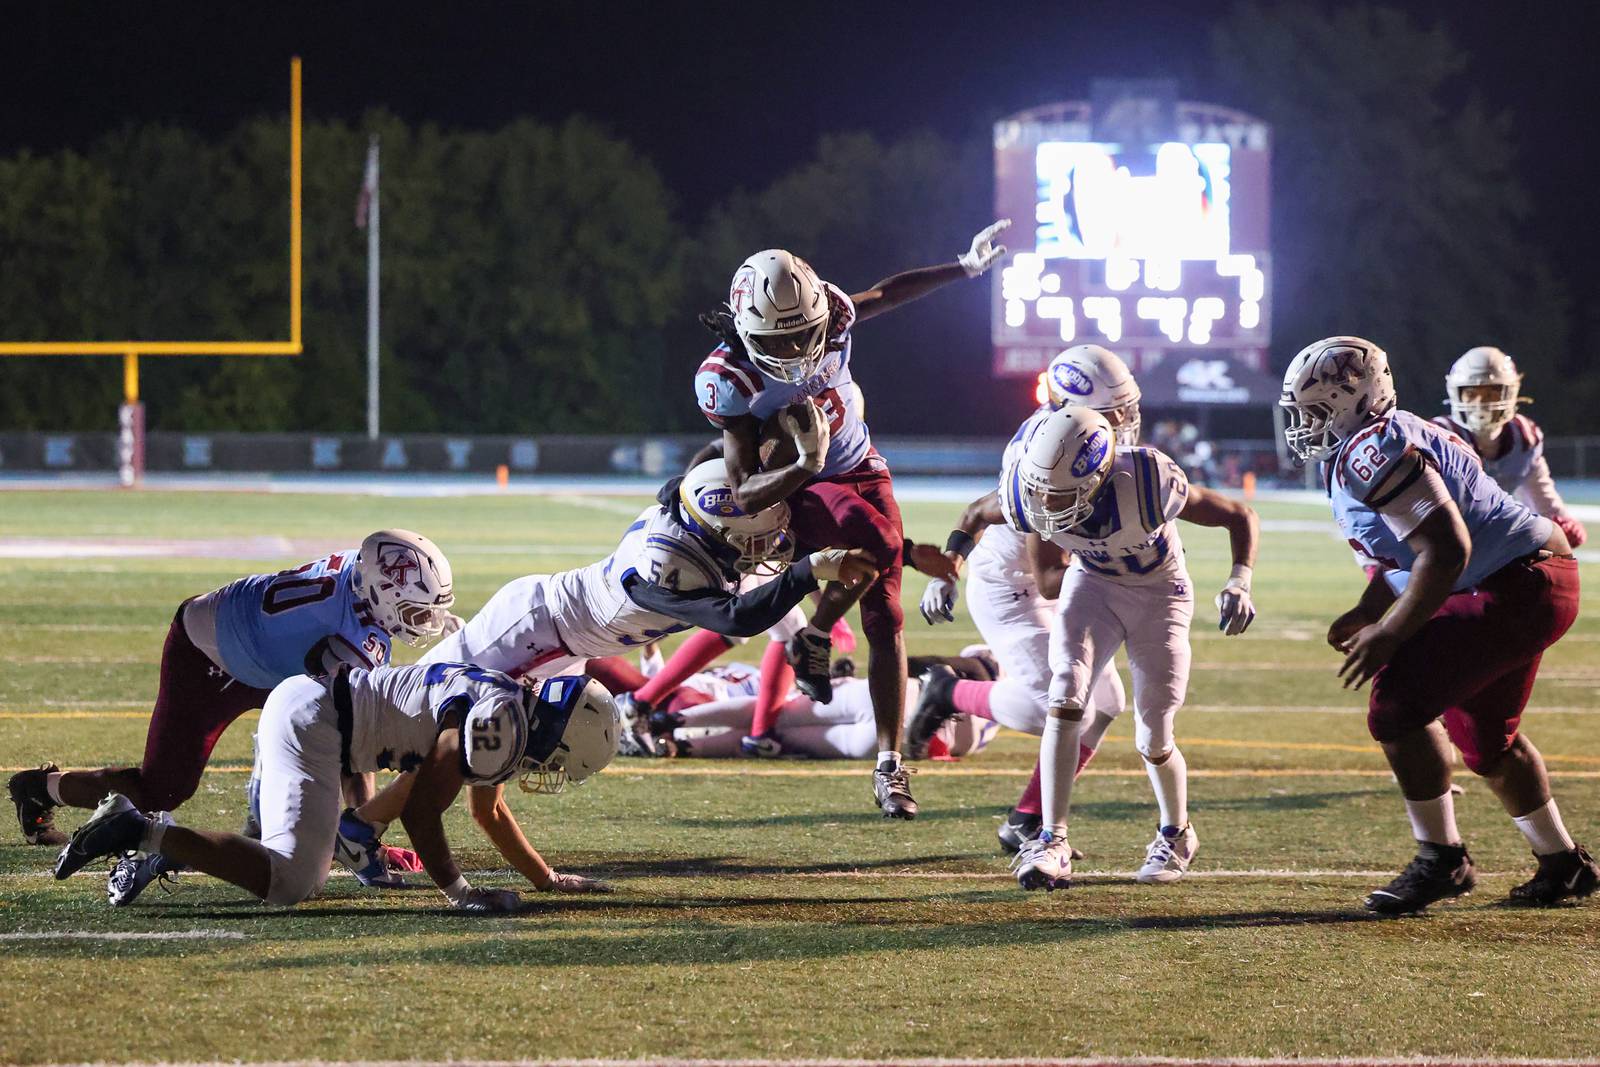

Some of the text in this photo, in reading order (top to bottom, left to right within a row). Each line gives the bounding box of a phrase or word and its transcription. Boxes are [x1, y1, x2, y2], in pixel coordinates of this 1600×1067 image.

[777, 318, 806, 329] Riddell
[705, 383, 717, 411] 3
[1350, 444, 1389, 482] 62
[704, 492, 734, 508] BLO
[650, 560, 681, 589] 54
[362, 632, 387, 665] 50
[471, 717, 501, 751] 52
